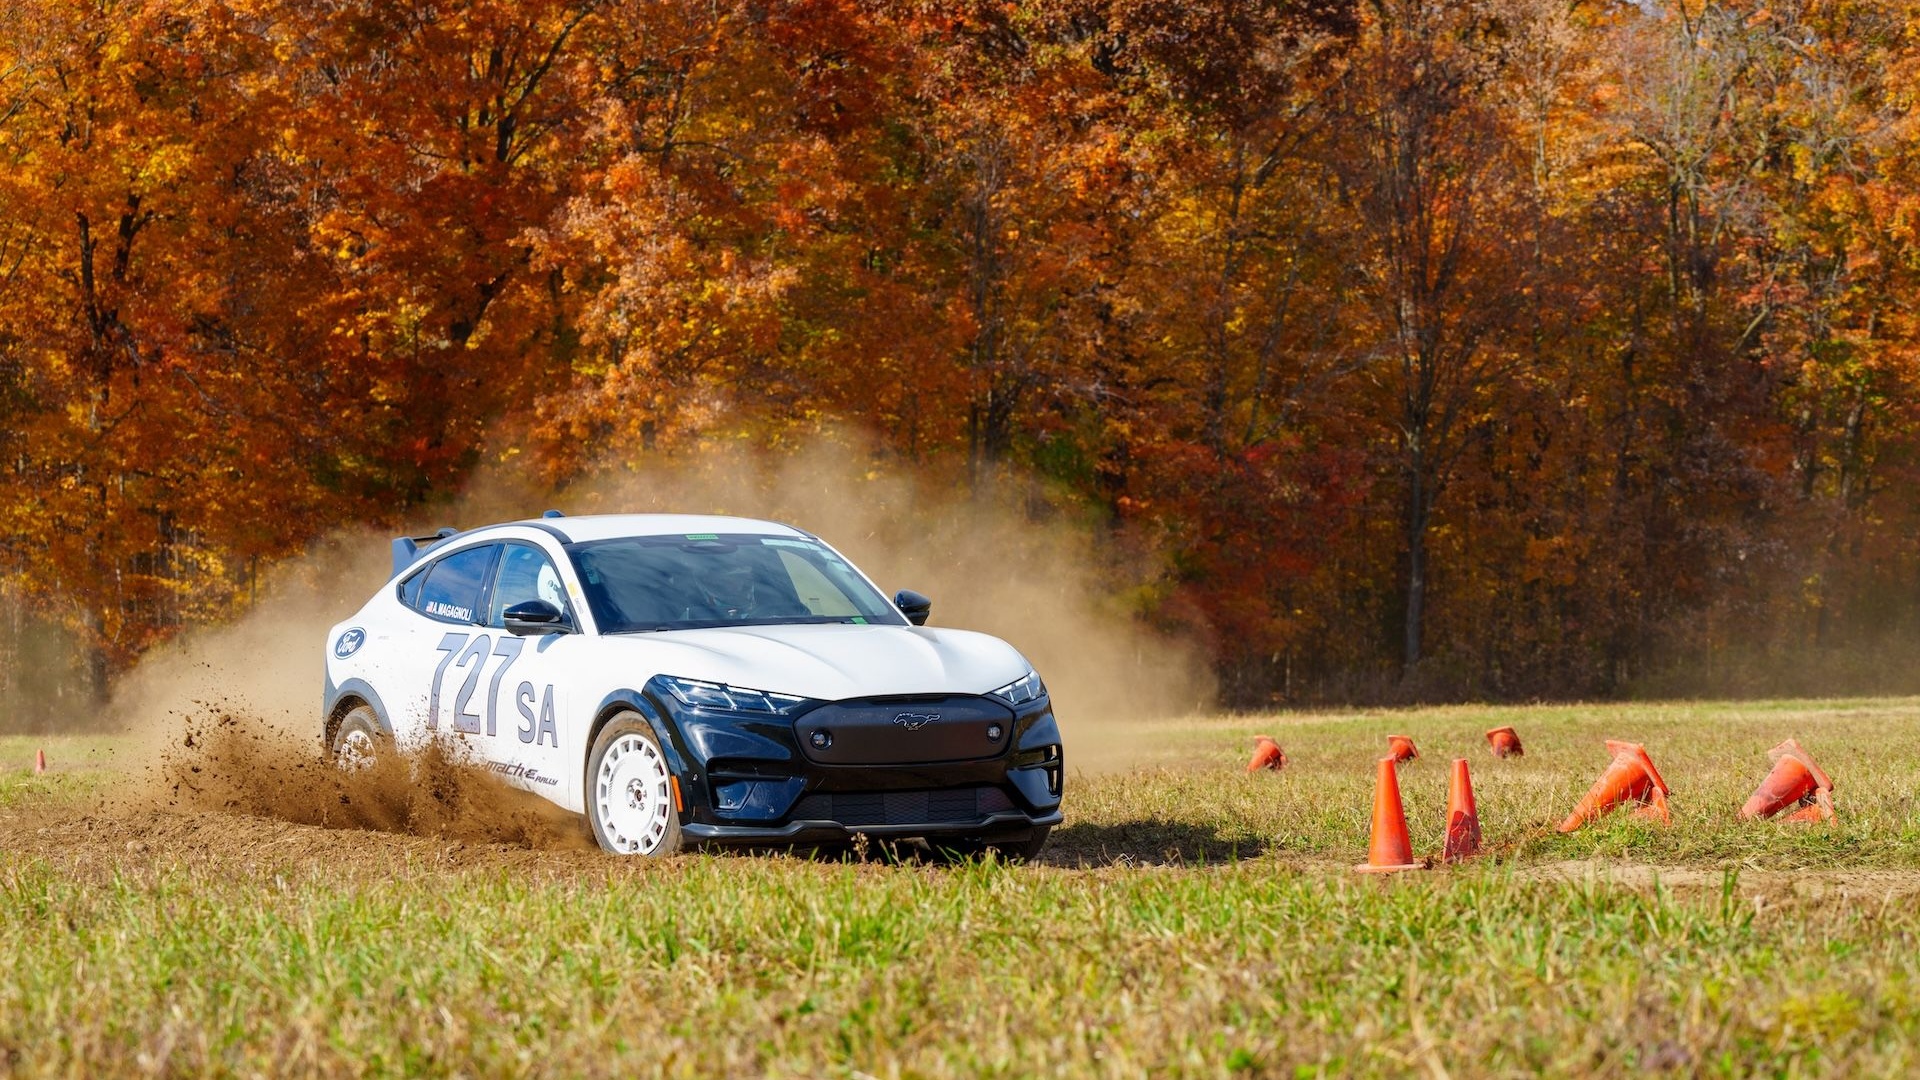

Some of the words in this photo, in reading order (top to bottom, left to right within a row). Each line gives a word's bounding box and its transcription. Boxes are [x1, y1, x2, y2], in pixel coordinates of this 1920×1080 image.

[337, 631, 361, 654] Ford
[429, 632, 526, 737] 727
[516, 681, 558, 748] SA
